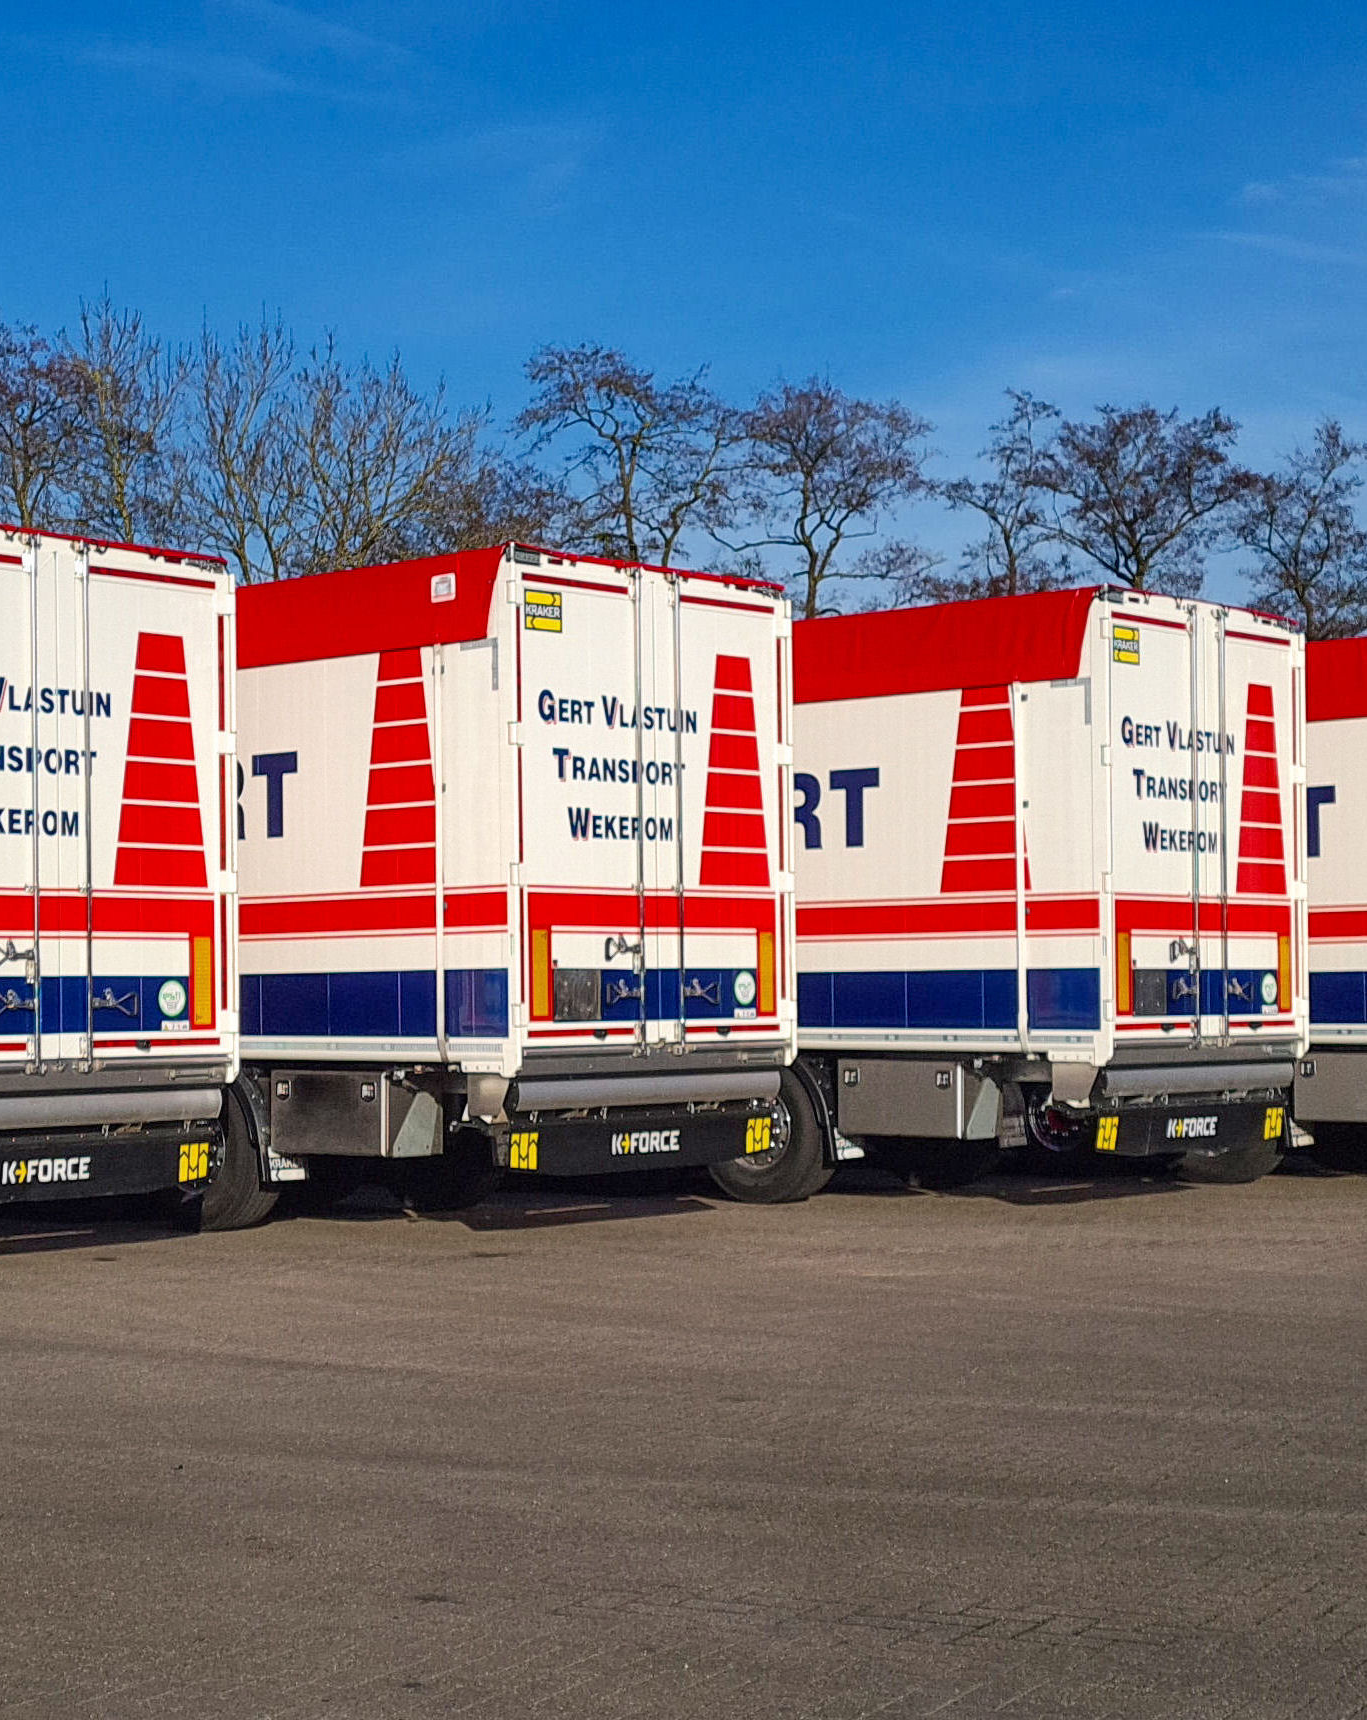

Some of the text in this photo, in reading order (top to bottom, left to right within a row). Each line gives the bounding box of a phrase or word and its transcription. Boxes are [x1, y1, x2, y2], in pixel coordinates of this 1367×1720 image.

[525, 603, 561, 619] KRAKER
[538, 689, 595, 725] GERT
[1121, 715, 1235, 756] GERT VLASTUN
